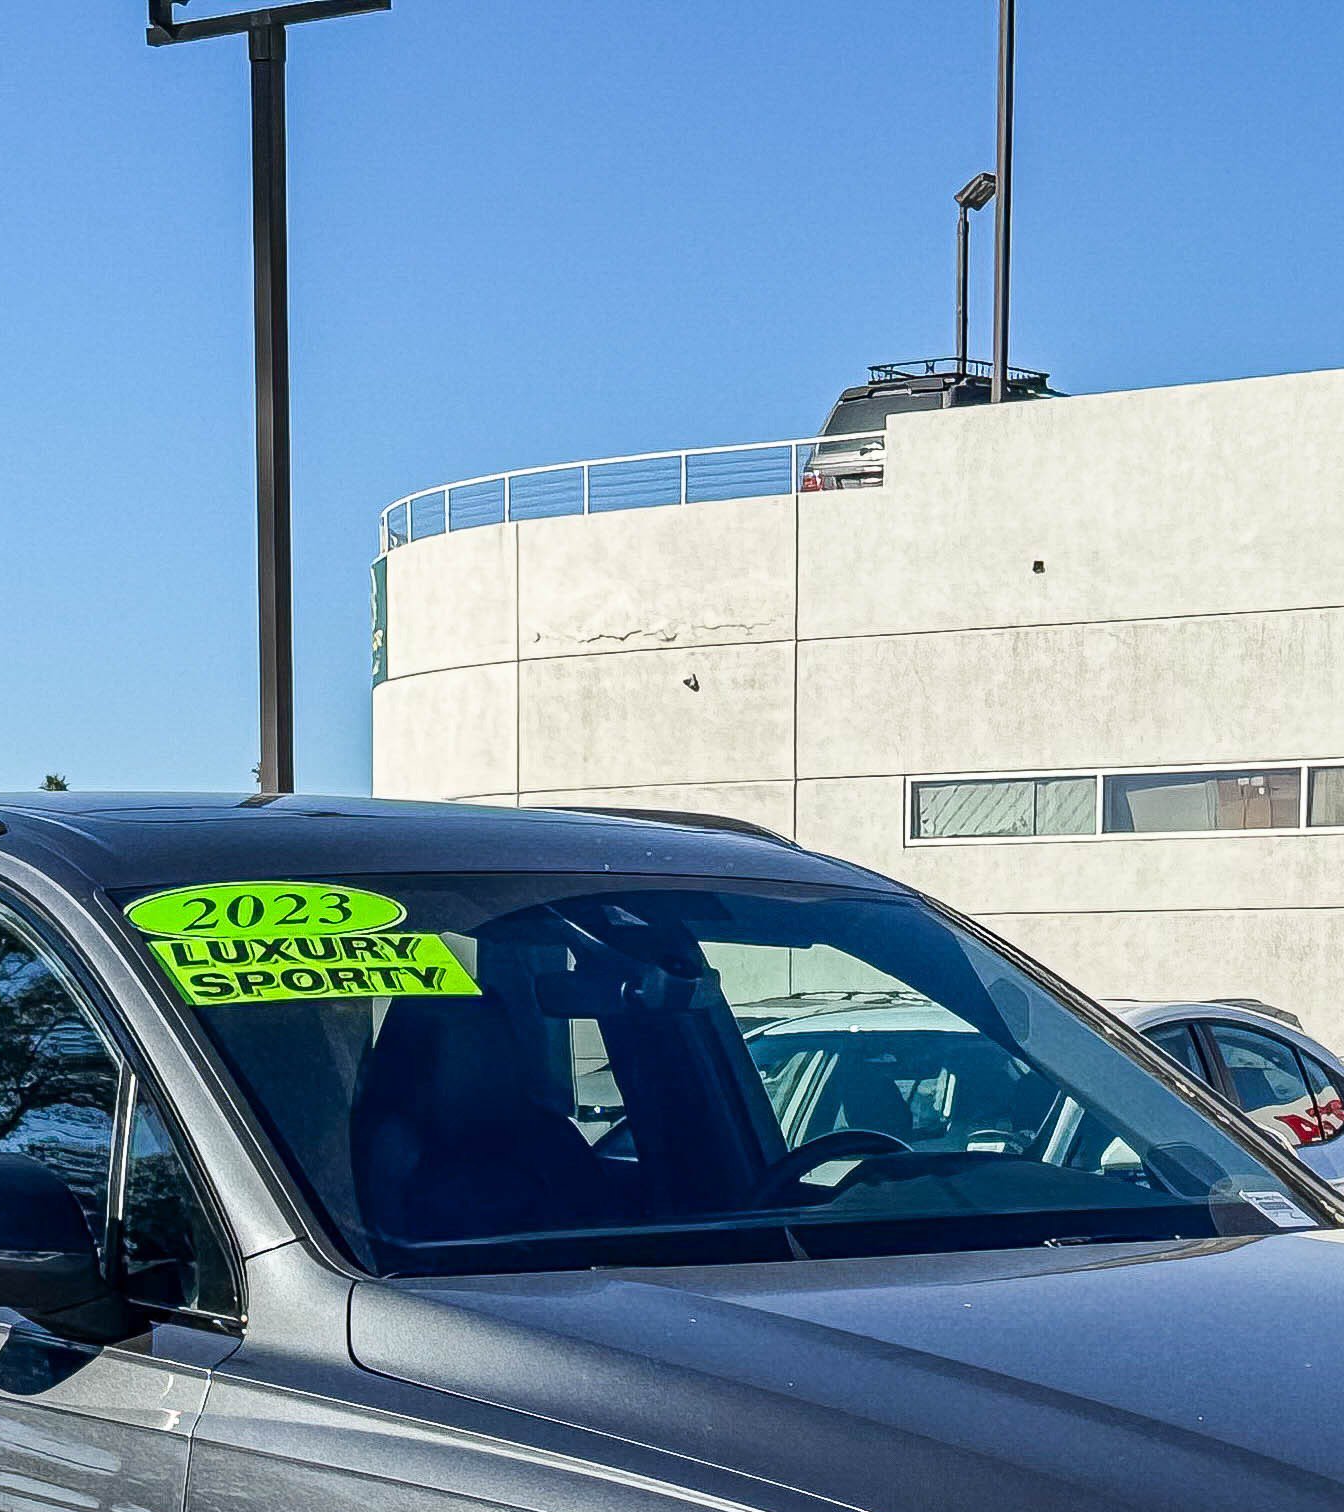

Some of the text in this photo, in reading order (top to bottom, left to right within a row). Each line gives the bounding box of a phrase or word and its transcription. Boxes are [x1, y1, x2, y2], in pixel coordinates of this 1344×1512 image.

[182, 892, 354, 932] 2023
[170, 935, 423, 969] LUXURY
[188, 965, 446, 1000] SPORTY
